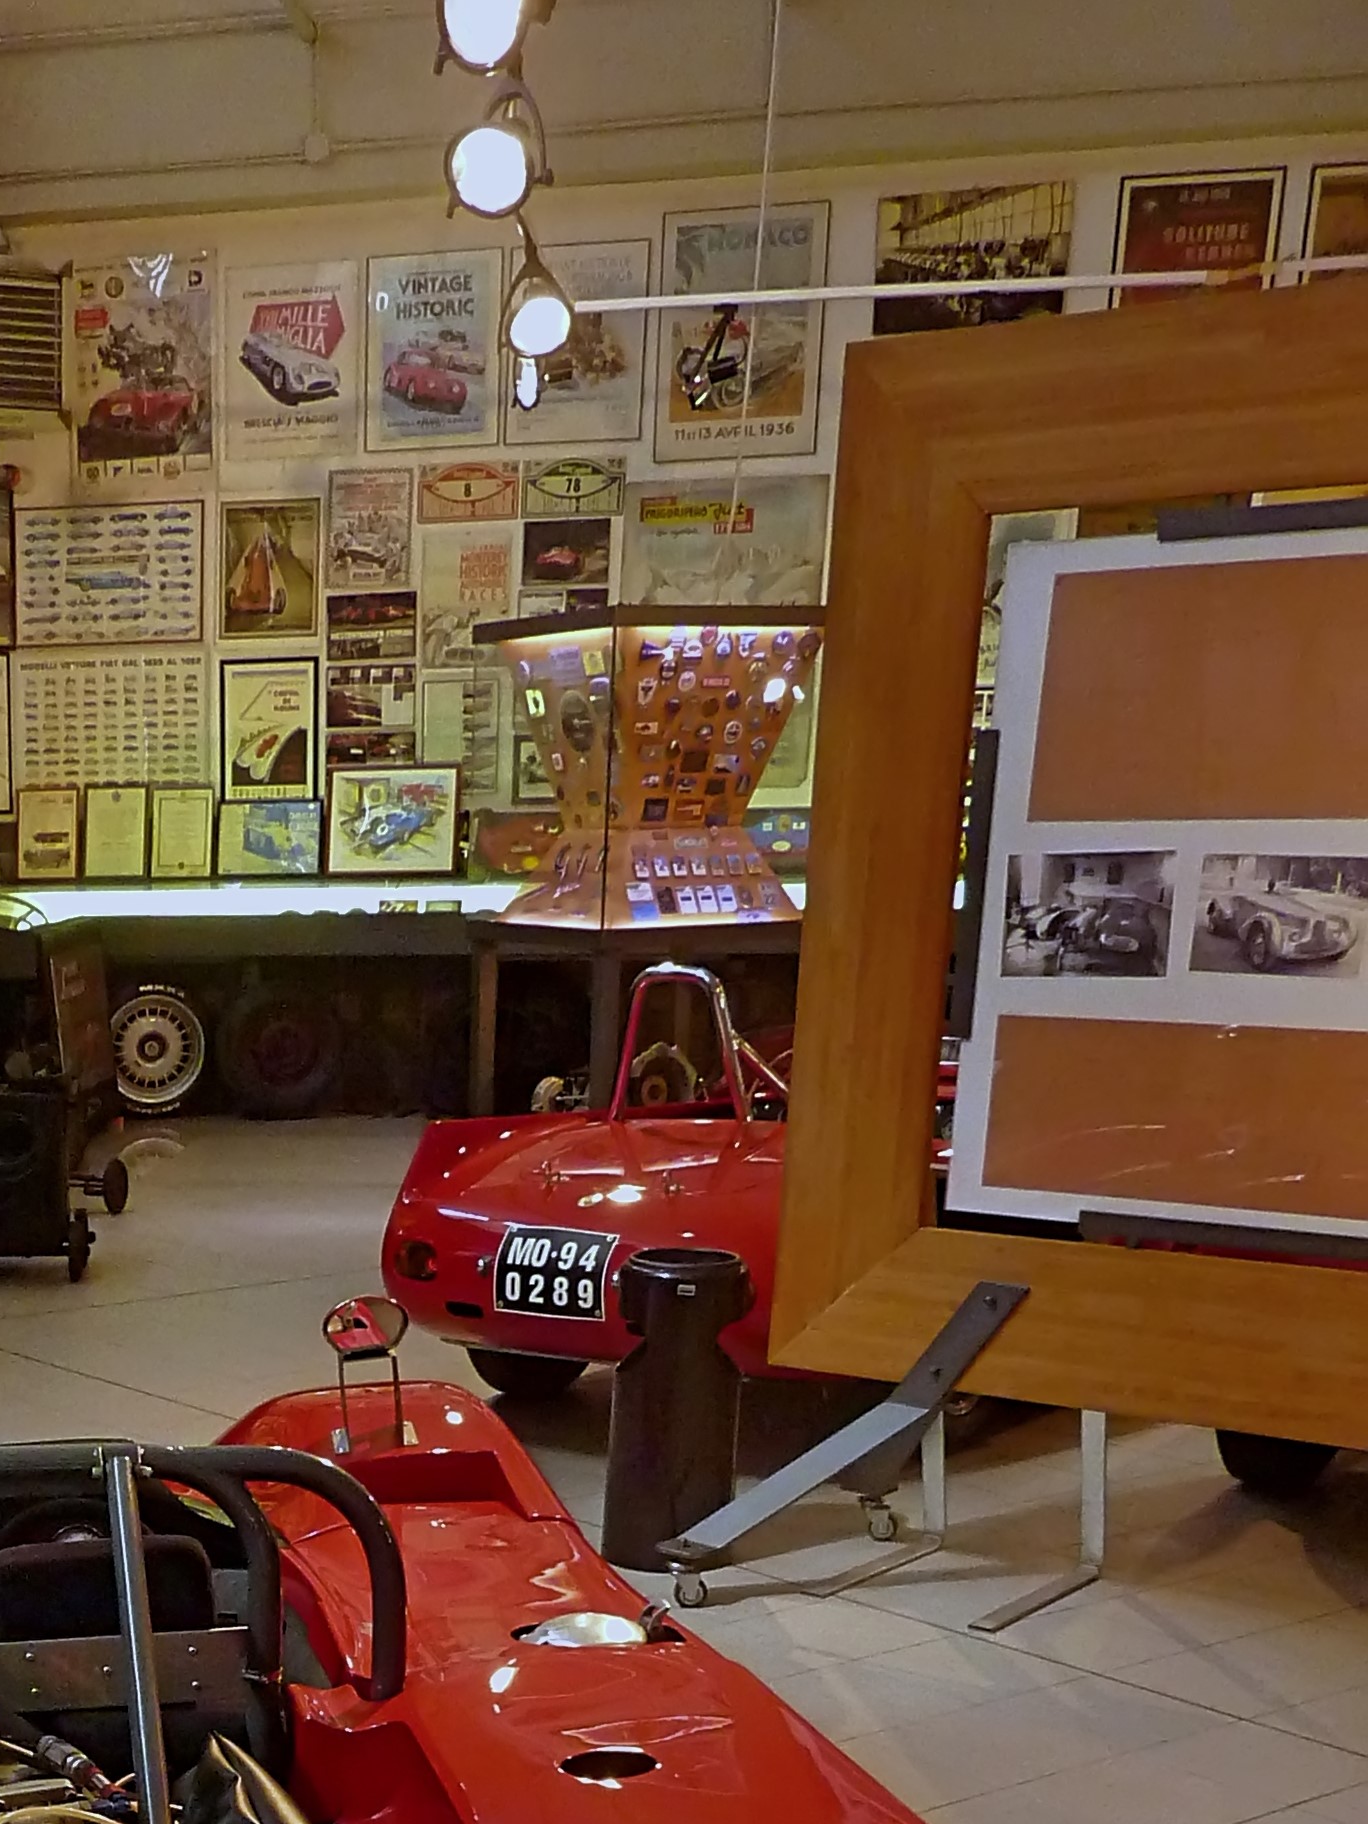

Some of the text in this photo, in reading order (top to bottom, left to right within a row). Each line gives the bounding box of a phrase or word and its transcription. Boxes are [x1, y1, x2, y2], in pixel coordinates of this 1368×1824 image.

[398, 274, 473, 296] VINTAGE
[279, 304, 331, 327] MILLE
[396, 298, 475, 321] HISTORIC
[698, 427, 712, 440] 13
[760, 421, 795, 437] 1936
[463, 482, 472, 498] 8
[566, 477, 581, 493] 78
[505, 1271, 595, 1309] 0289
